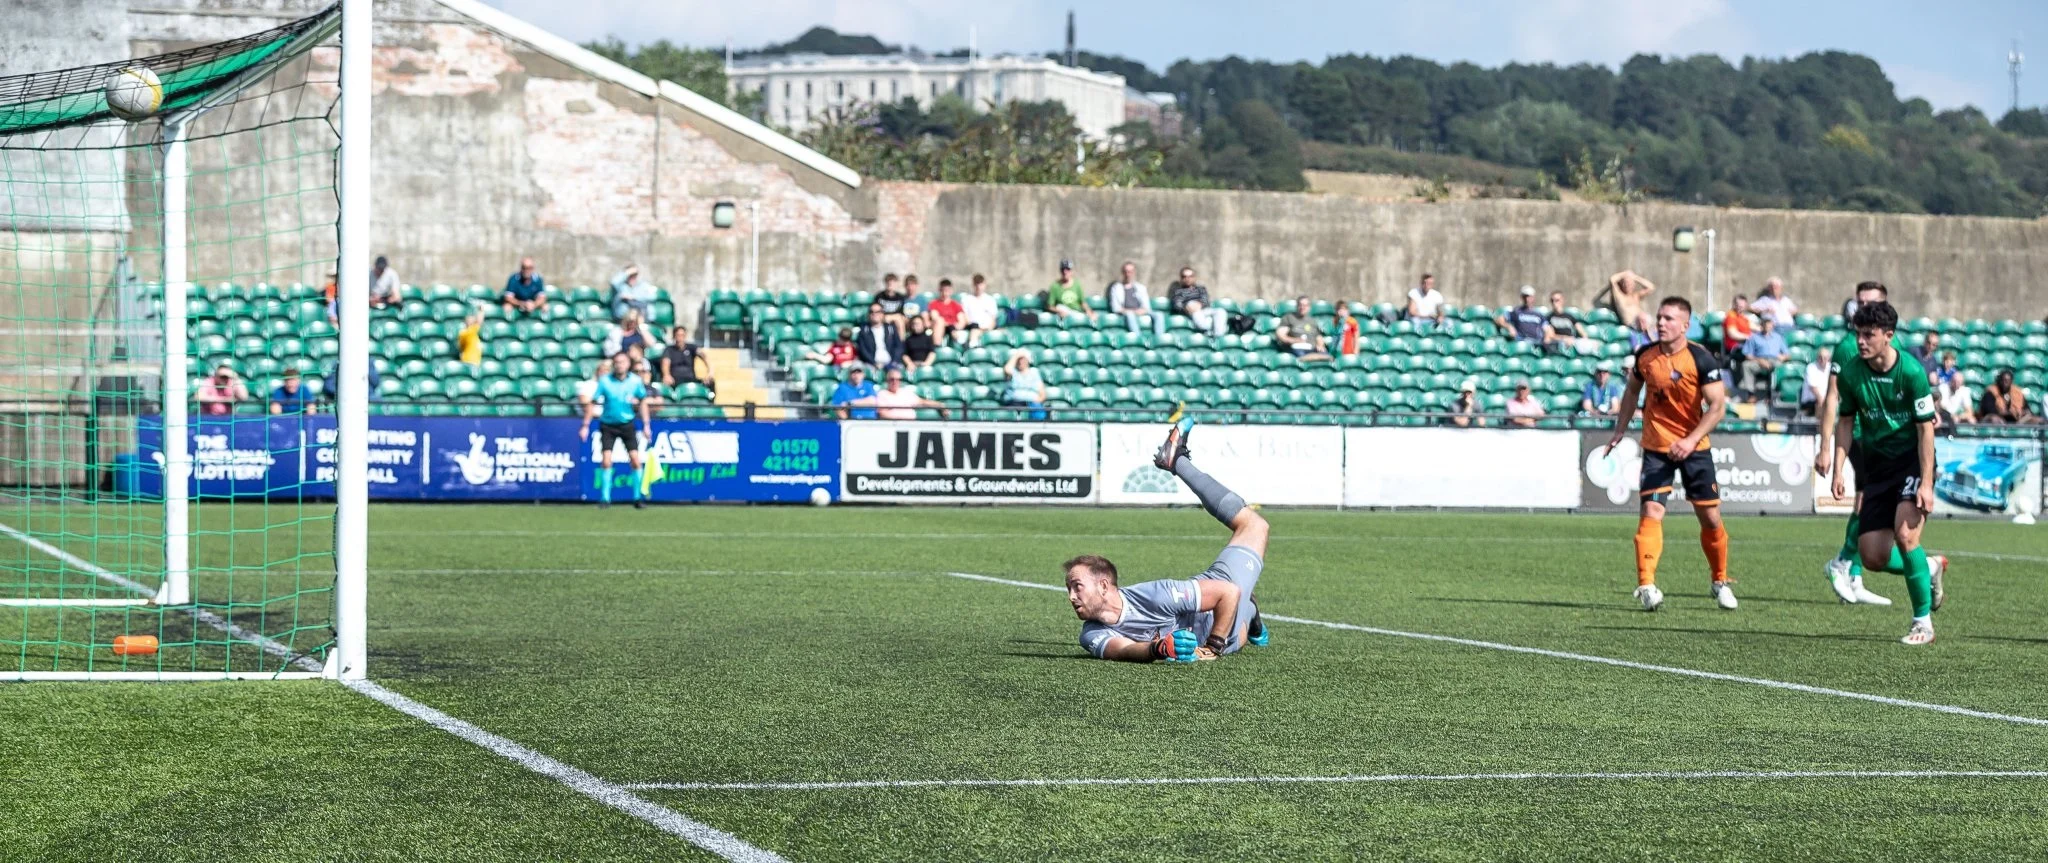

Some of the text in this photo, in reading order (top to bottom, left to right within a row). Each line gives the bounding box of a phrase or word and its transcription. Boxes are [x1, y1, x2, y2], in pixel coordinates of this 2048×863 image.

[316, 428, 417, 446] SURTING
[495, 437, 529, 452] THE
[771, 438, 820, 455] 01570
[878, 431, 1062, 470] JAMES
[316, 447, 414, 465] COUNITY
[495, 452, 576, 468] NATIONAL
[762, 455, 819, 471] 421421
[495, 467, 570, 483] LOTTERY
[856, 476, 1079, 494] Developments & Groundworks Ltd
[1720, 487, 1793, 505] Decorating
